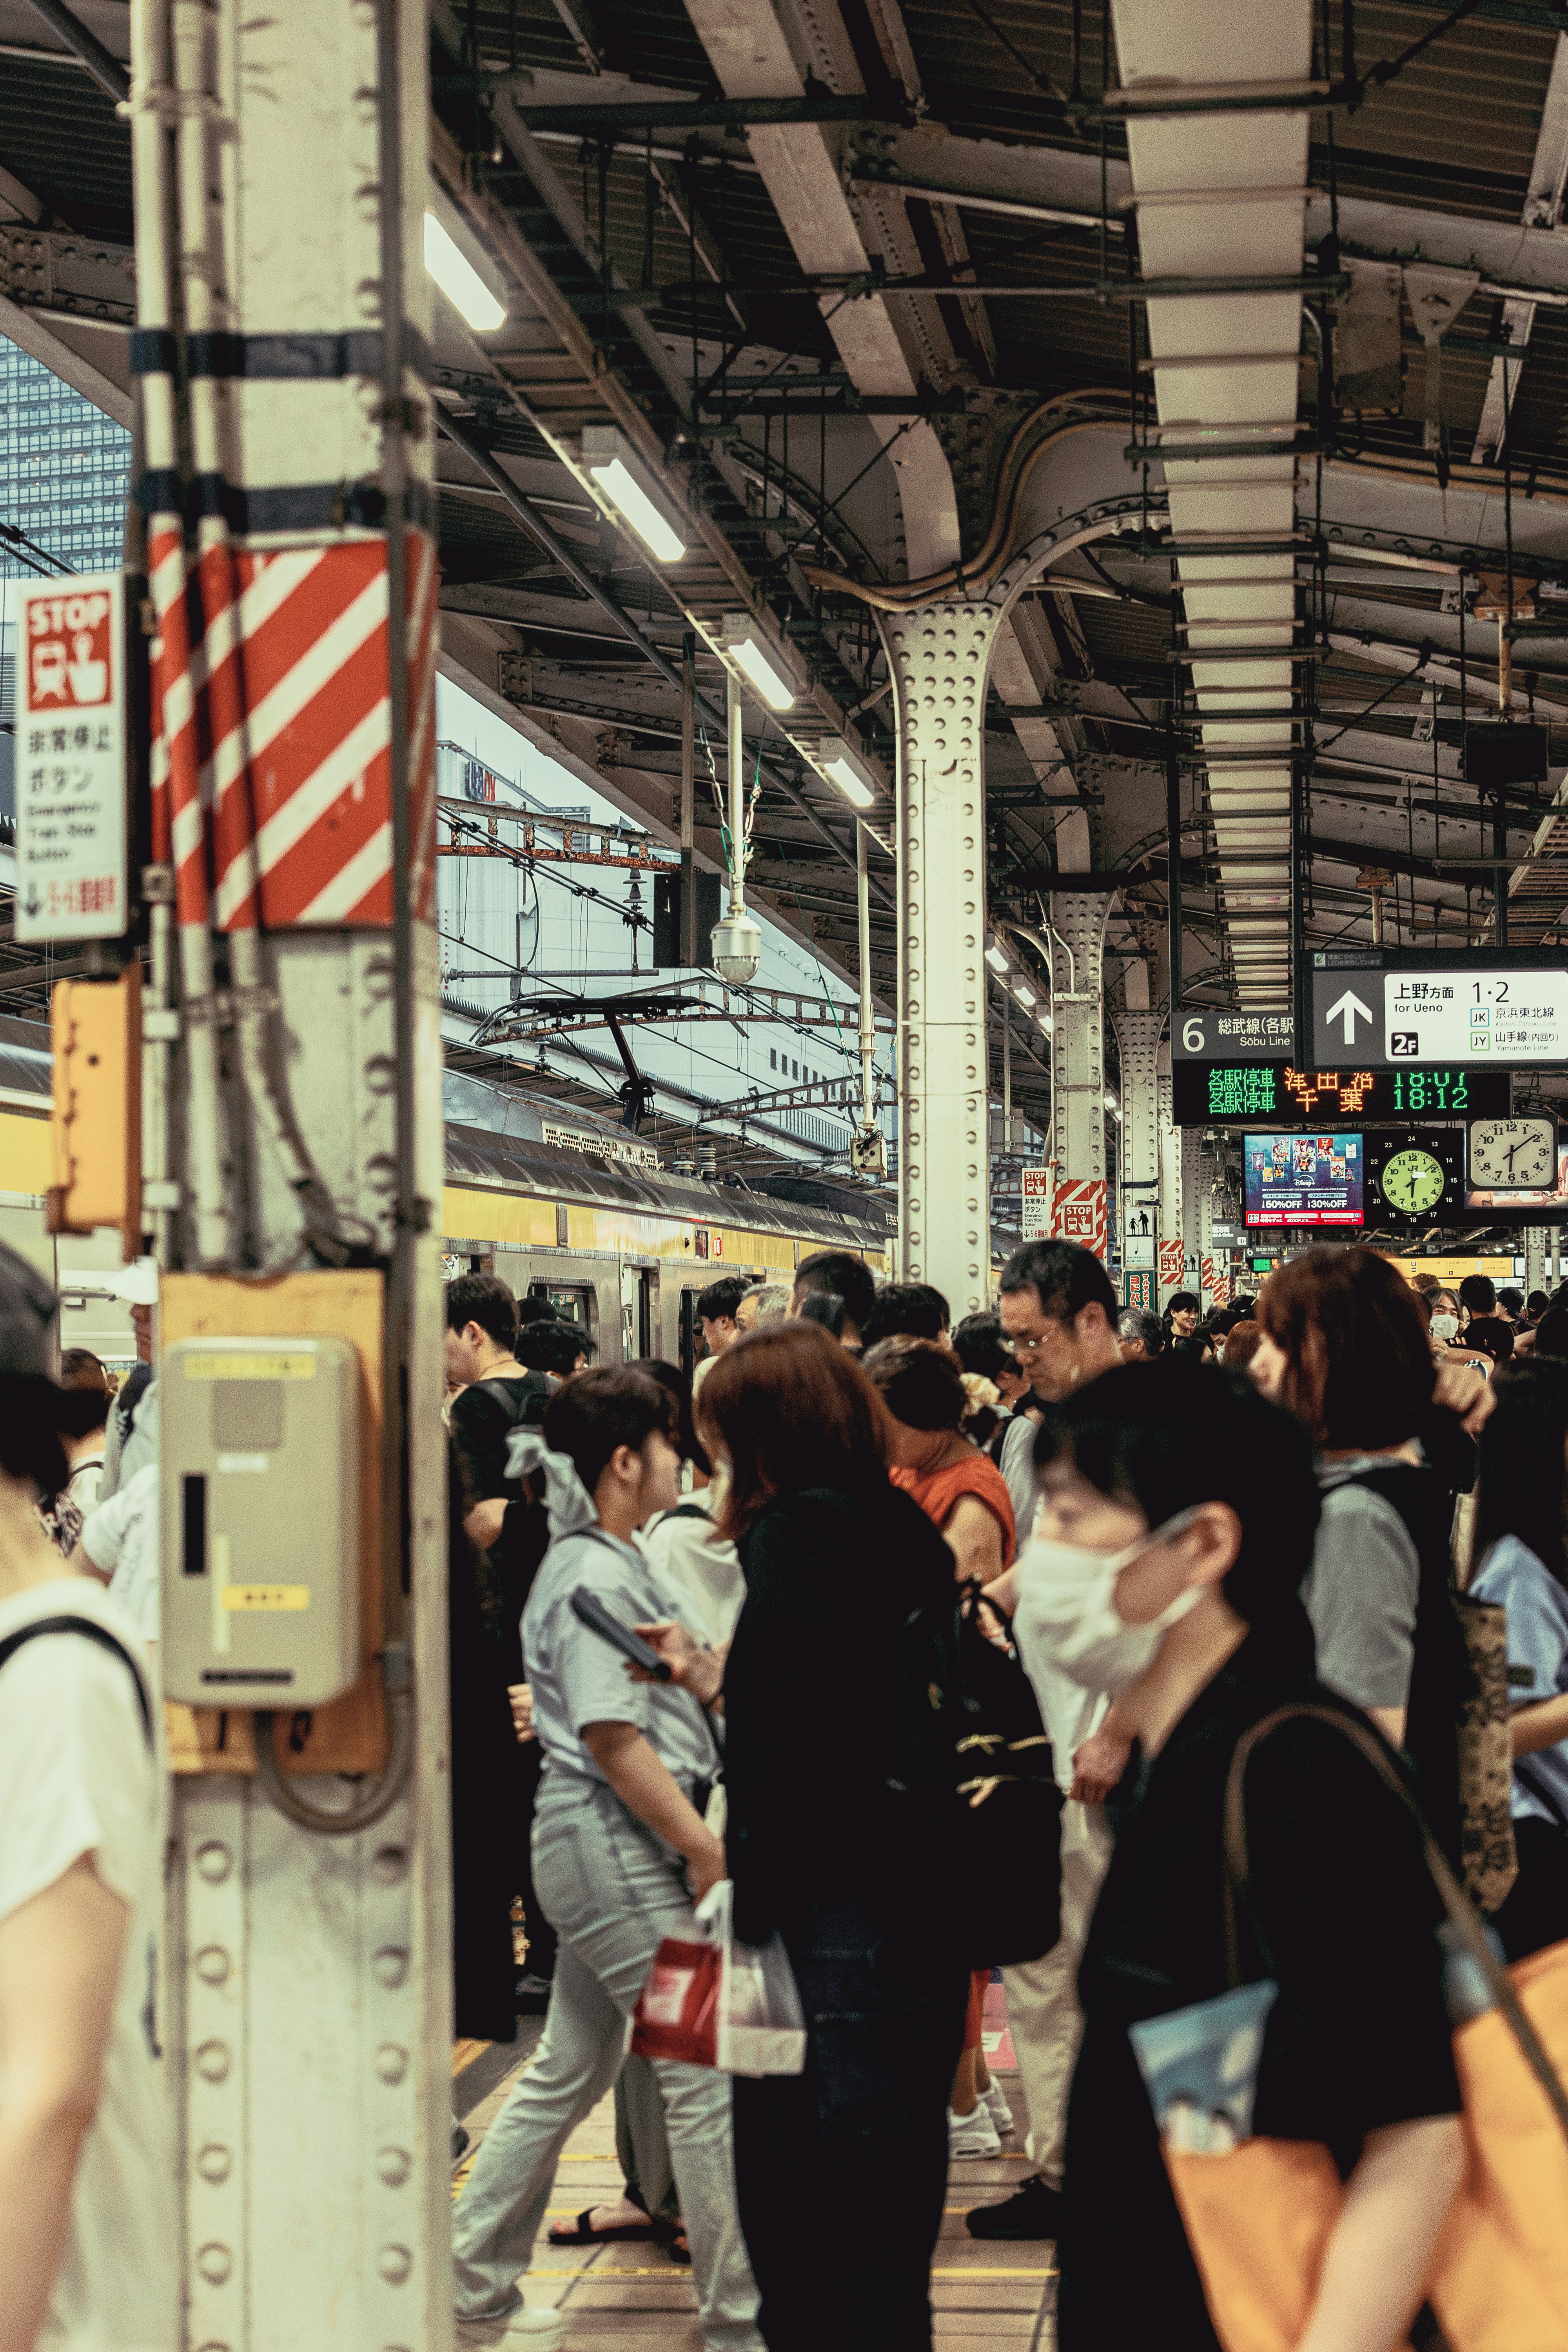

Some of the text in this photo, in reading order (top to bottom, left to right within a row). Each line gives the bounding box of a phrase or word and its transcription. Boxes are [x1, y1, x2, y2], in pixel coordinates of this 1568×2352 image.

[1394, 983, 1454, 999] 上野方面
[1395, 1004, 1443, 1012] for Ueno
[1495, 1007, 1554, 1018] 京浜東北線
[1474, 1013, 1486, 1022] JK
[1183, 1018, 1205, 1052] 6
[1240, 1036, 1290, 1046] Sōbu Line
[1394, 1034, 1416, 1054] 2F
[1474, 1037, 1486, 1046] JY
[1209, 1068, 1275, 1091] 各駅停車
[1209, 1087, 1468, 1114] 各駅停車 千葉 18:12
[1477, 1149, 1485, 1157] 9
[1539, 1148, 1546, 1156] 3
[1293, 1178, 1316, 1187] Disney+
[1066, 1207, 1091, 1215] STOP
